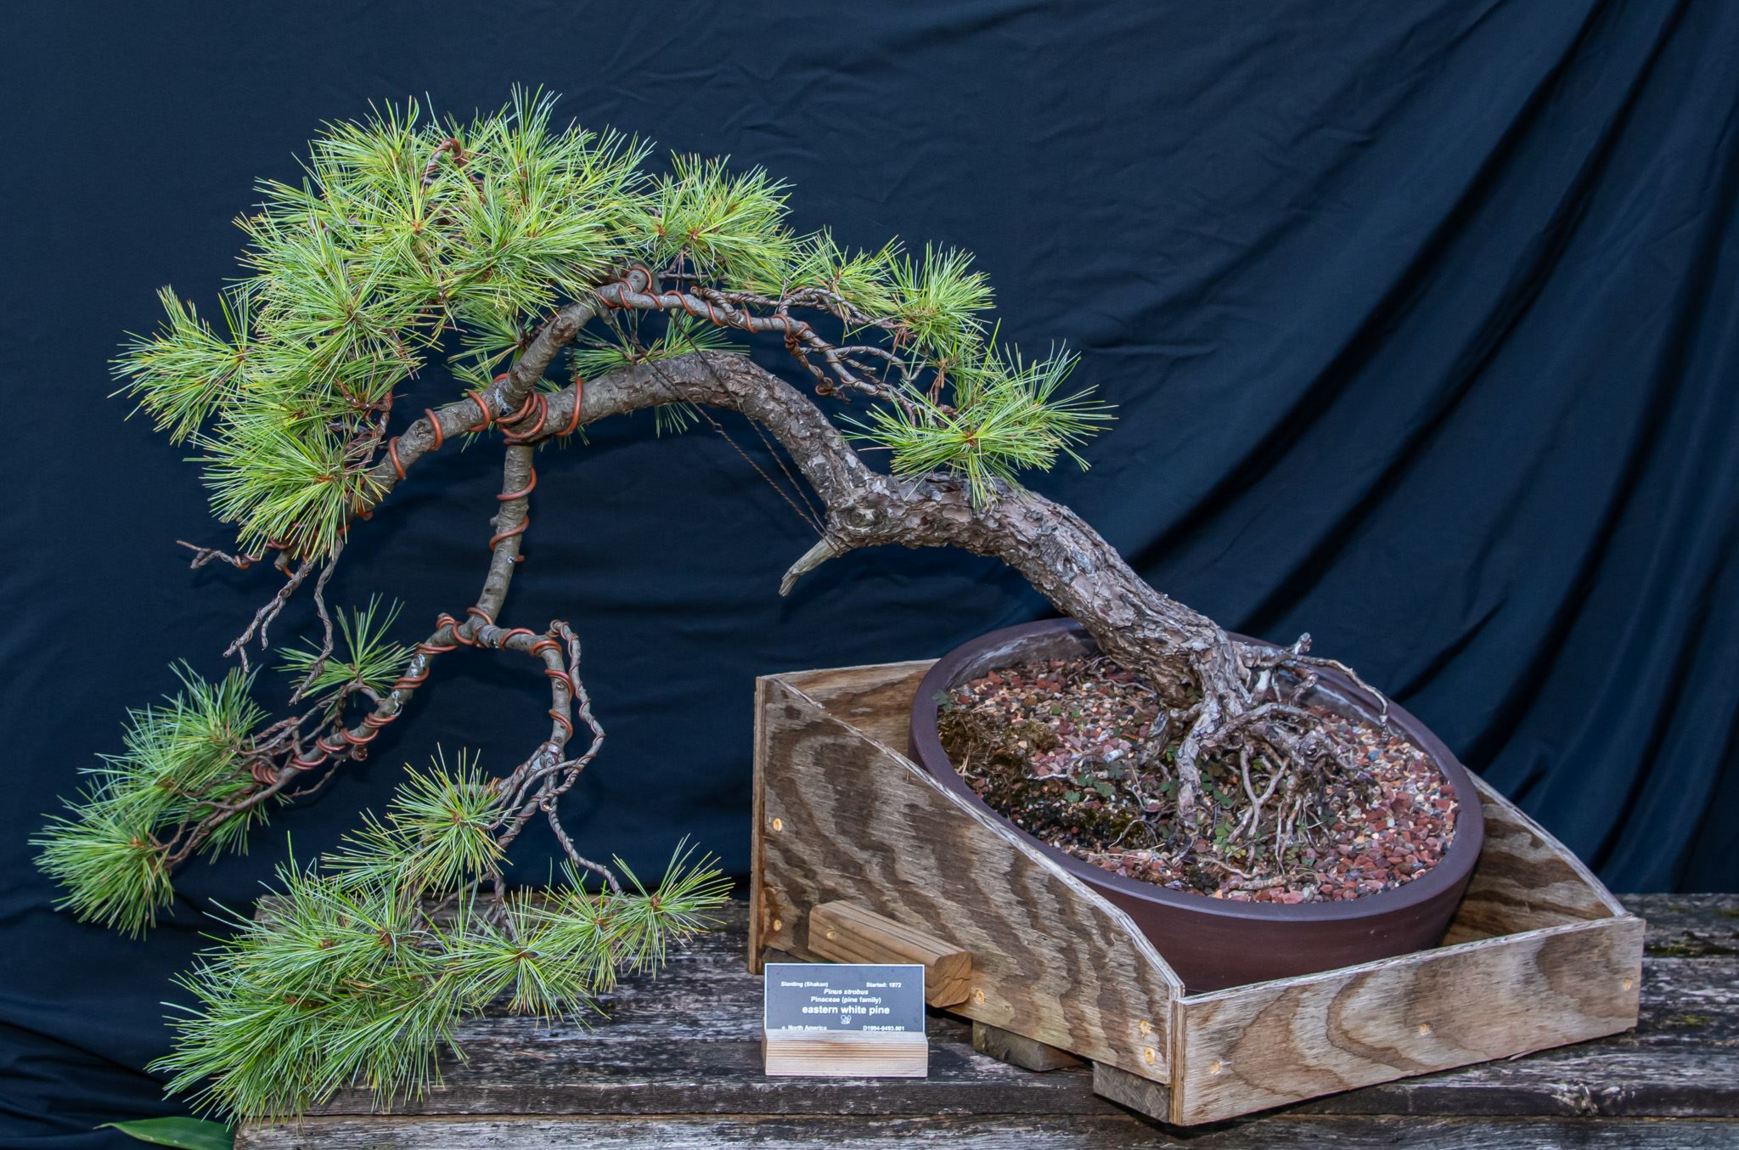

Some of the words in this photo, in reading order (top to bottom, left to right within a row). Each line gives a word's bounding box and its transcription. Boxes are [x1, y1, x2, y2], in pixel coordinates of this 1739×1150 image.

[841, 996, 858, 1004] (pine
[859, 996, 882, 1004] family)
[802, 1005, 838, 1014] eastern
[840, 1005, 867, 1014] white
[869, 1005, 890, 1016] pine
